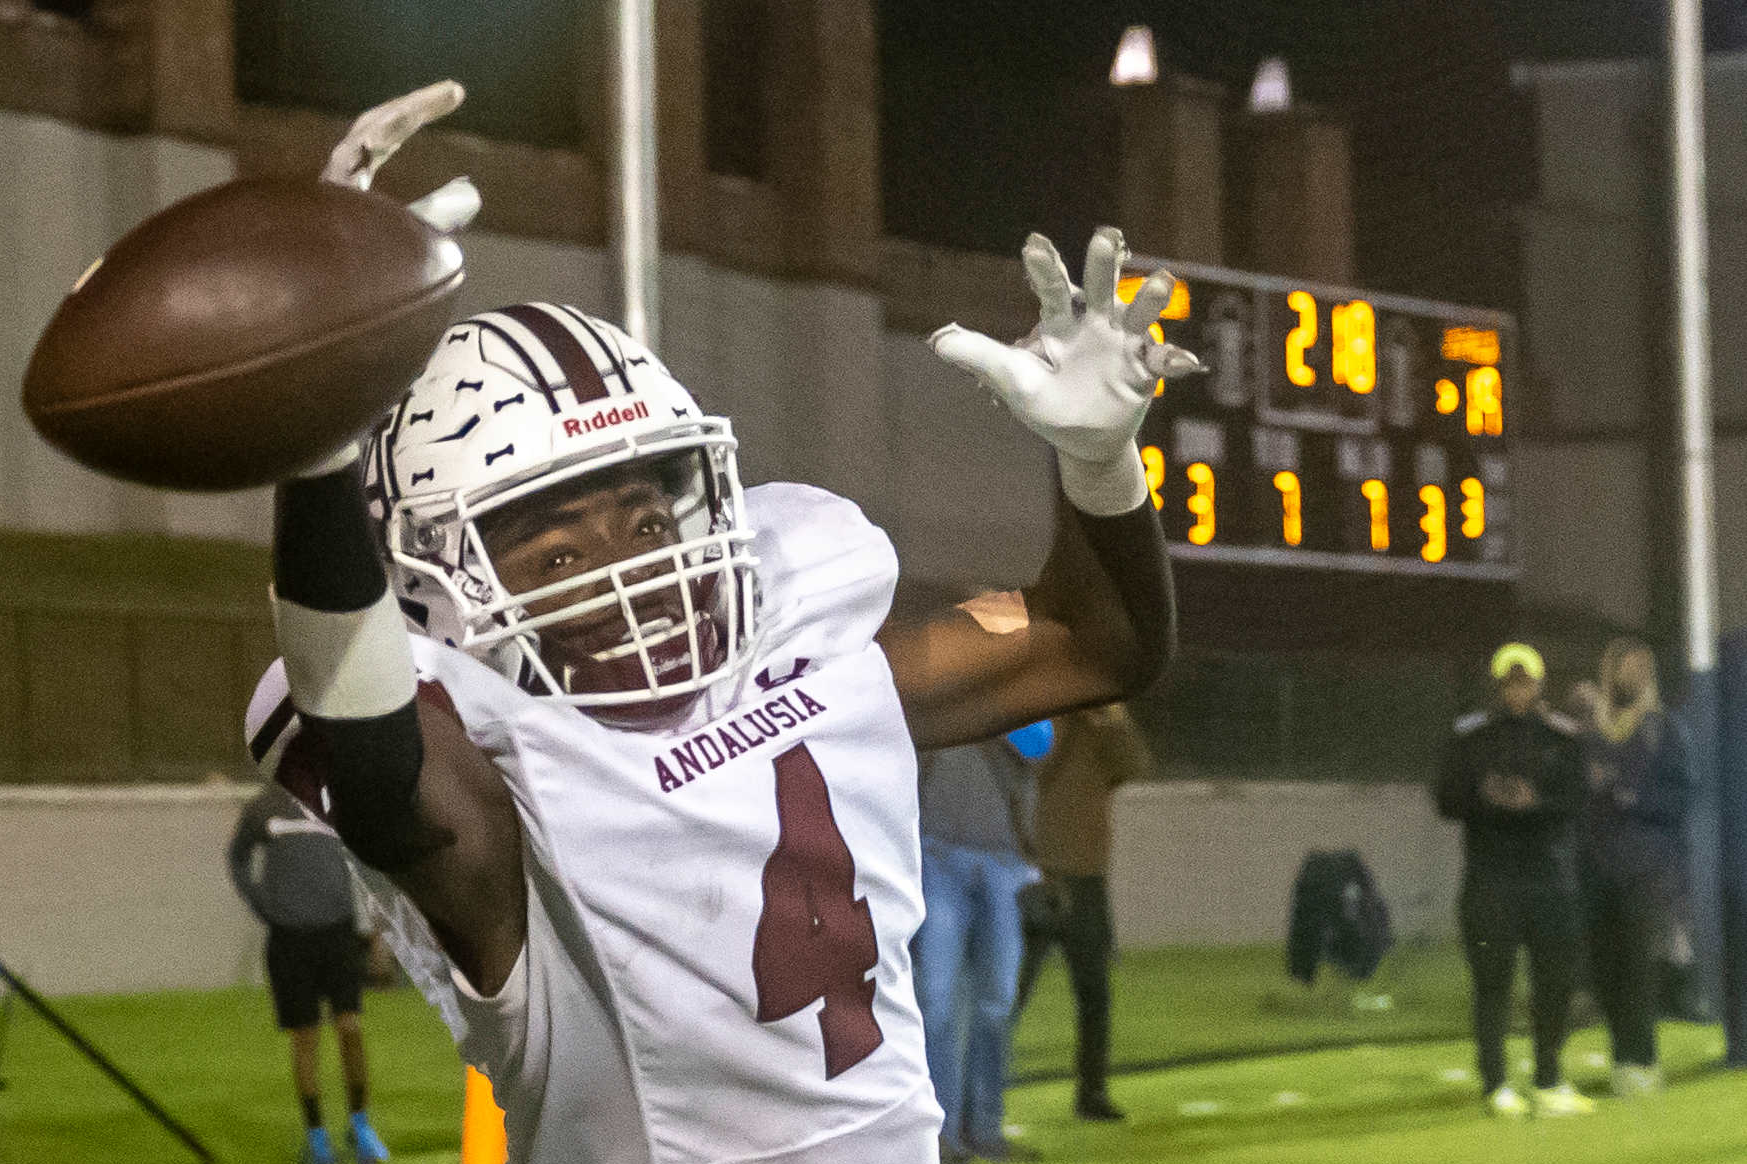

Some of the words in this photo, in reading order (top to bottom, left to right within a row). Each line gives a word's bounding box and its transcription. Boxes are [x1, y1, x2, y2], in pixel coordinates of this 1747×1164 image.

[563, 400, 650, 438] Riddell
[1187, 462, 1216, 545] 3
[1419, 484, 1447, 563] 3
[654, 687, 828, 794] ANDALUSIA
[752, 740, 884, 1081] 4
